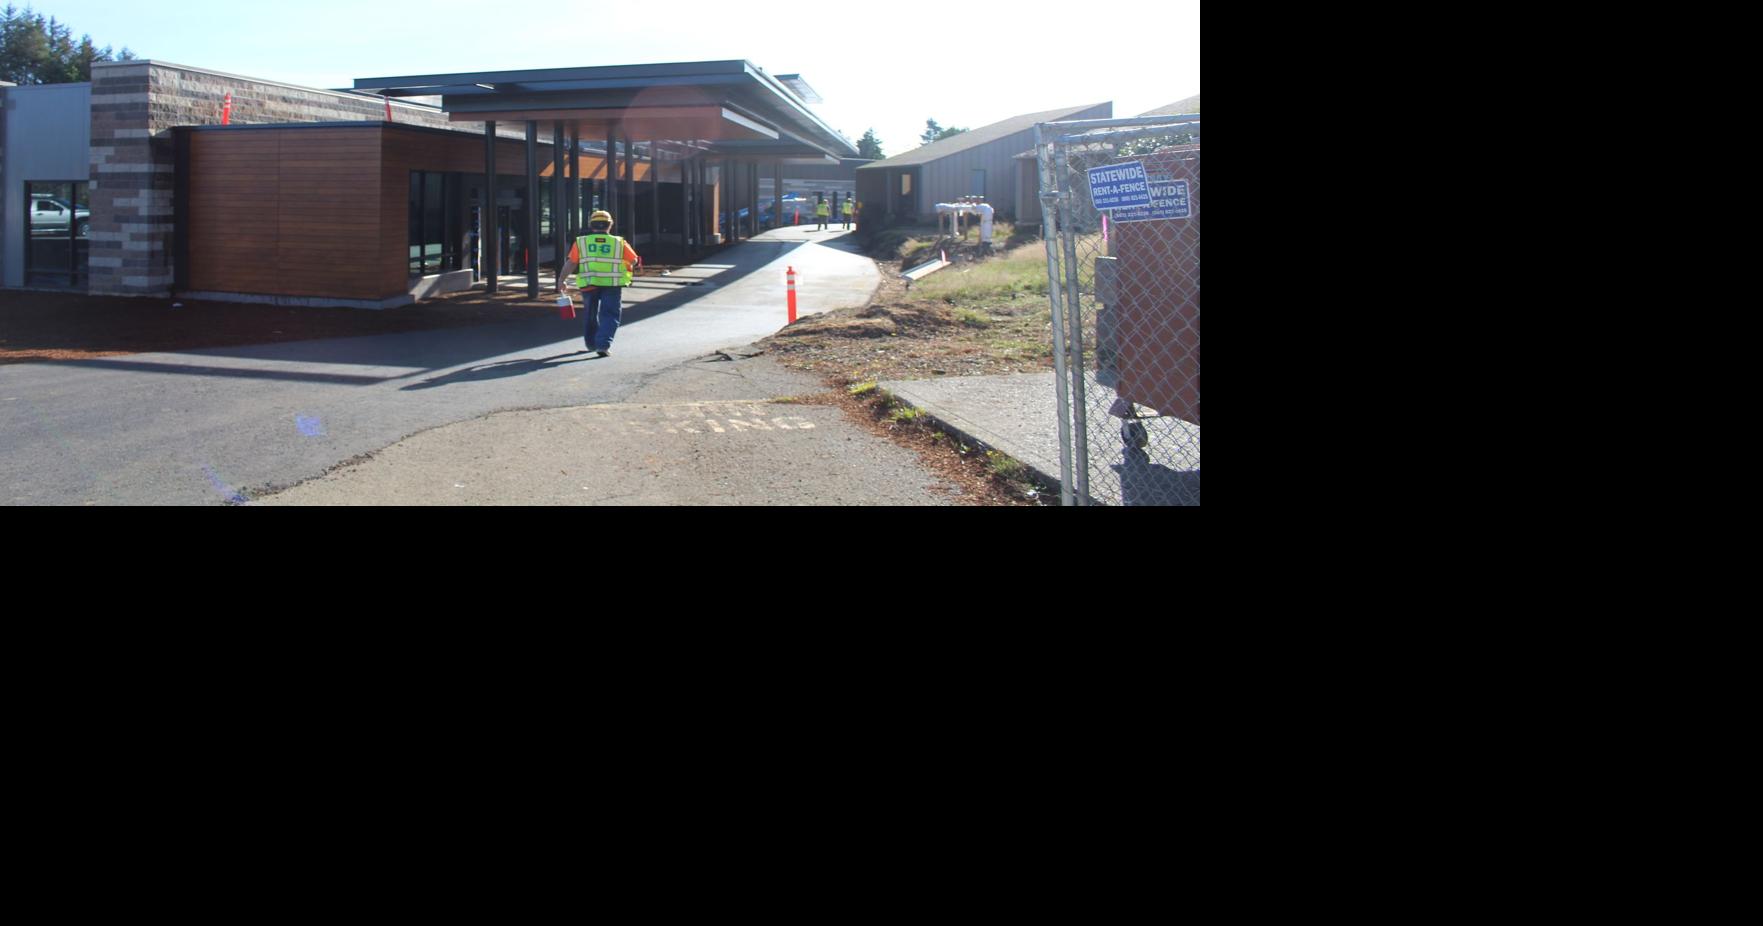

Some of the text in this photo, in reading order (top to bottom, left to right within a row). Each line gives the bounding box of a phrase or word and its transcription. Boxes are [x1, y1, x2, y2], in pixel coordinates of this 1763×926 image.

[1091, 166, 1143, 184] STATEWIDE
[1093, 182, 1146, 196] RENT-A-FENCE
[1150, 185, 1185, 197] WIDE
